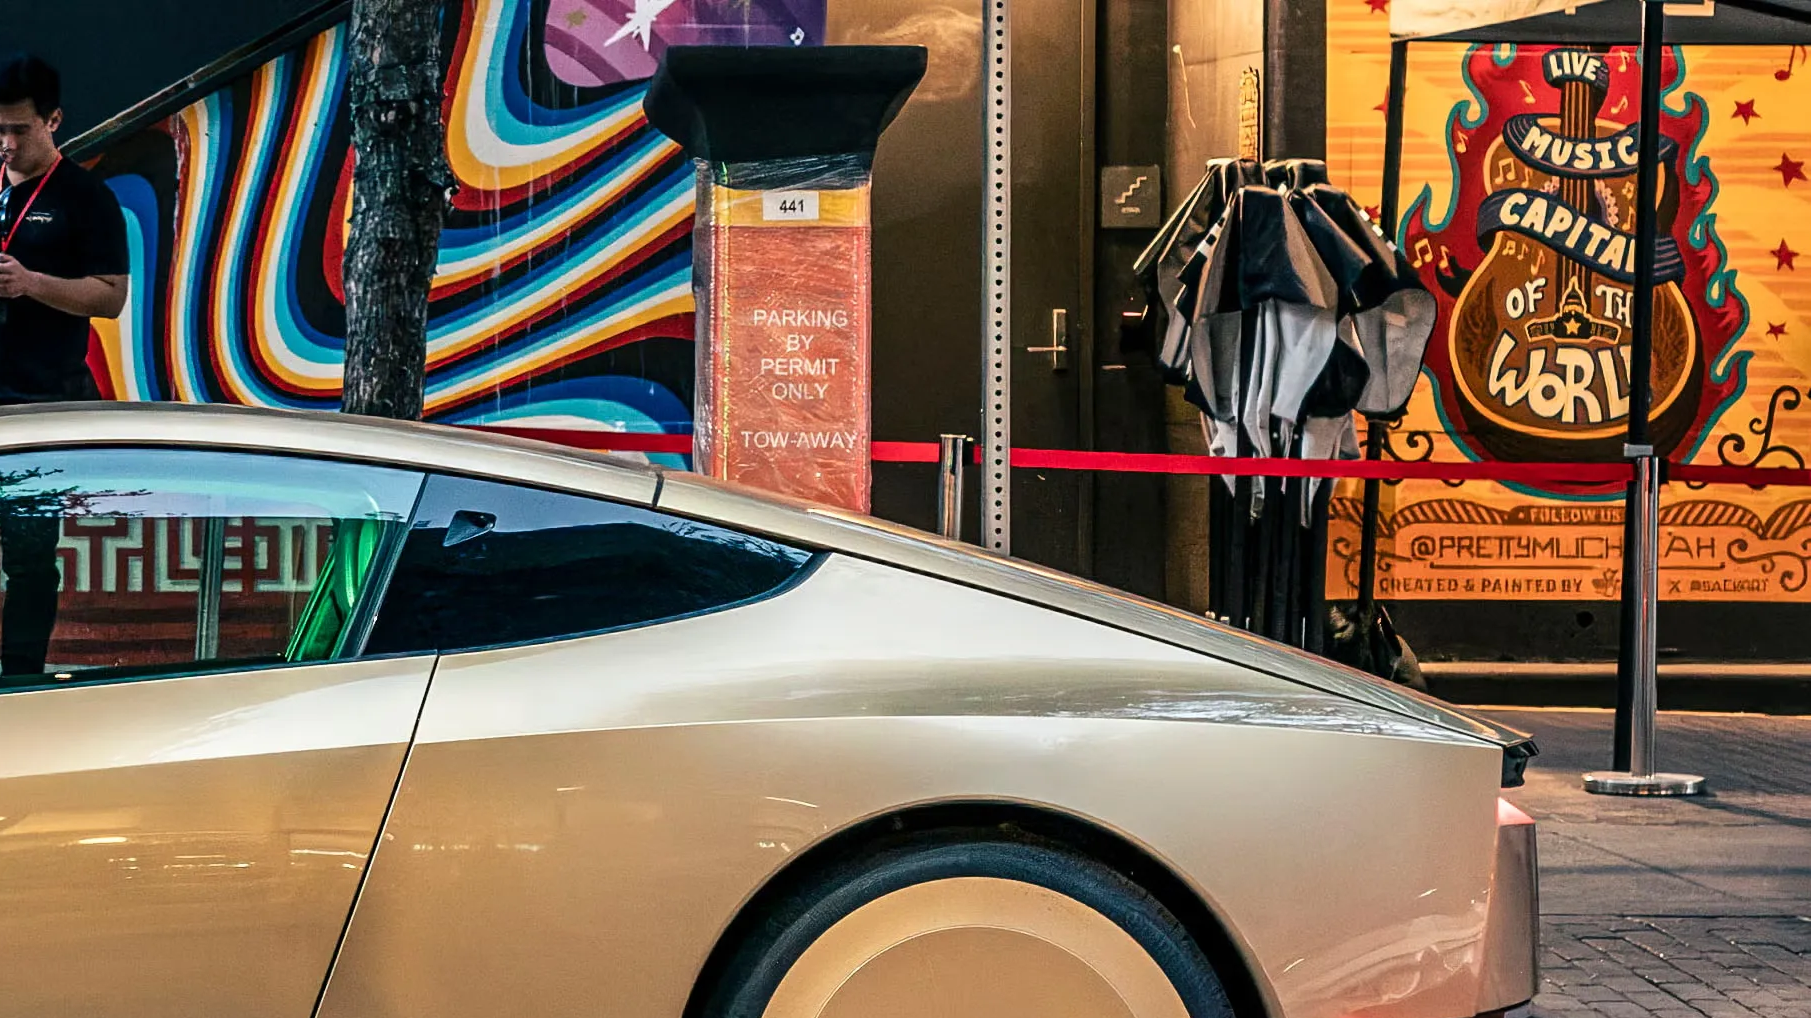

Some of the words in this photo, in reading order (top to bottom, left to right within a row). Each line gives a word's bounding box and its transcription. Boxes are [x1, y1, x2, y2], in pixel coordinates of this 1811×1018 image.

[1549, 51, 1601, 81] LIVE
[1521, 126, 1639, 169] MUSIC
[779, 199, 805, 213] 441
[1505, 277, 1546, 319] OF
[1595, 284, 1634, 328] TH
[753, 309, 849, 329] PARKING
[786, 334, 814, 353] BY
[760, 358, 840, 376] PERMIT
[1489, 331, 1632, 423] WORL
[771, 382, 829, 400] ONLY
[741, 431, 857, 449] TOW-AWAY
[1530, 507, 1596, 523] FOLLOW
[1600, 508, 1621, 523] US
[1411, 535, 1716, 561] @PRETTYMUCHAH
[1379, 578, 1458, 593] CREATED
[1481, 578, 1556, 593] PAINTED
[1561, 578, 1583, 593] BY
